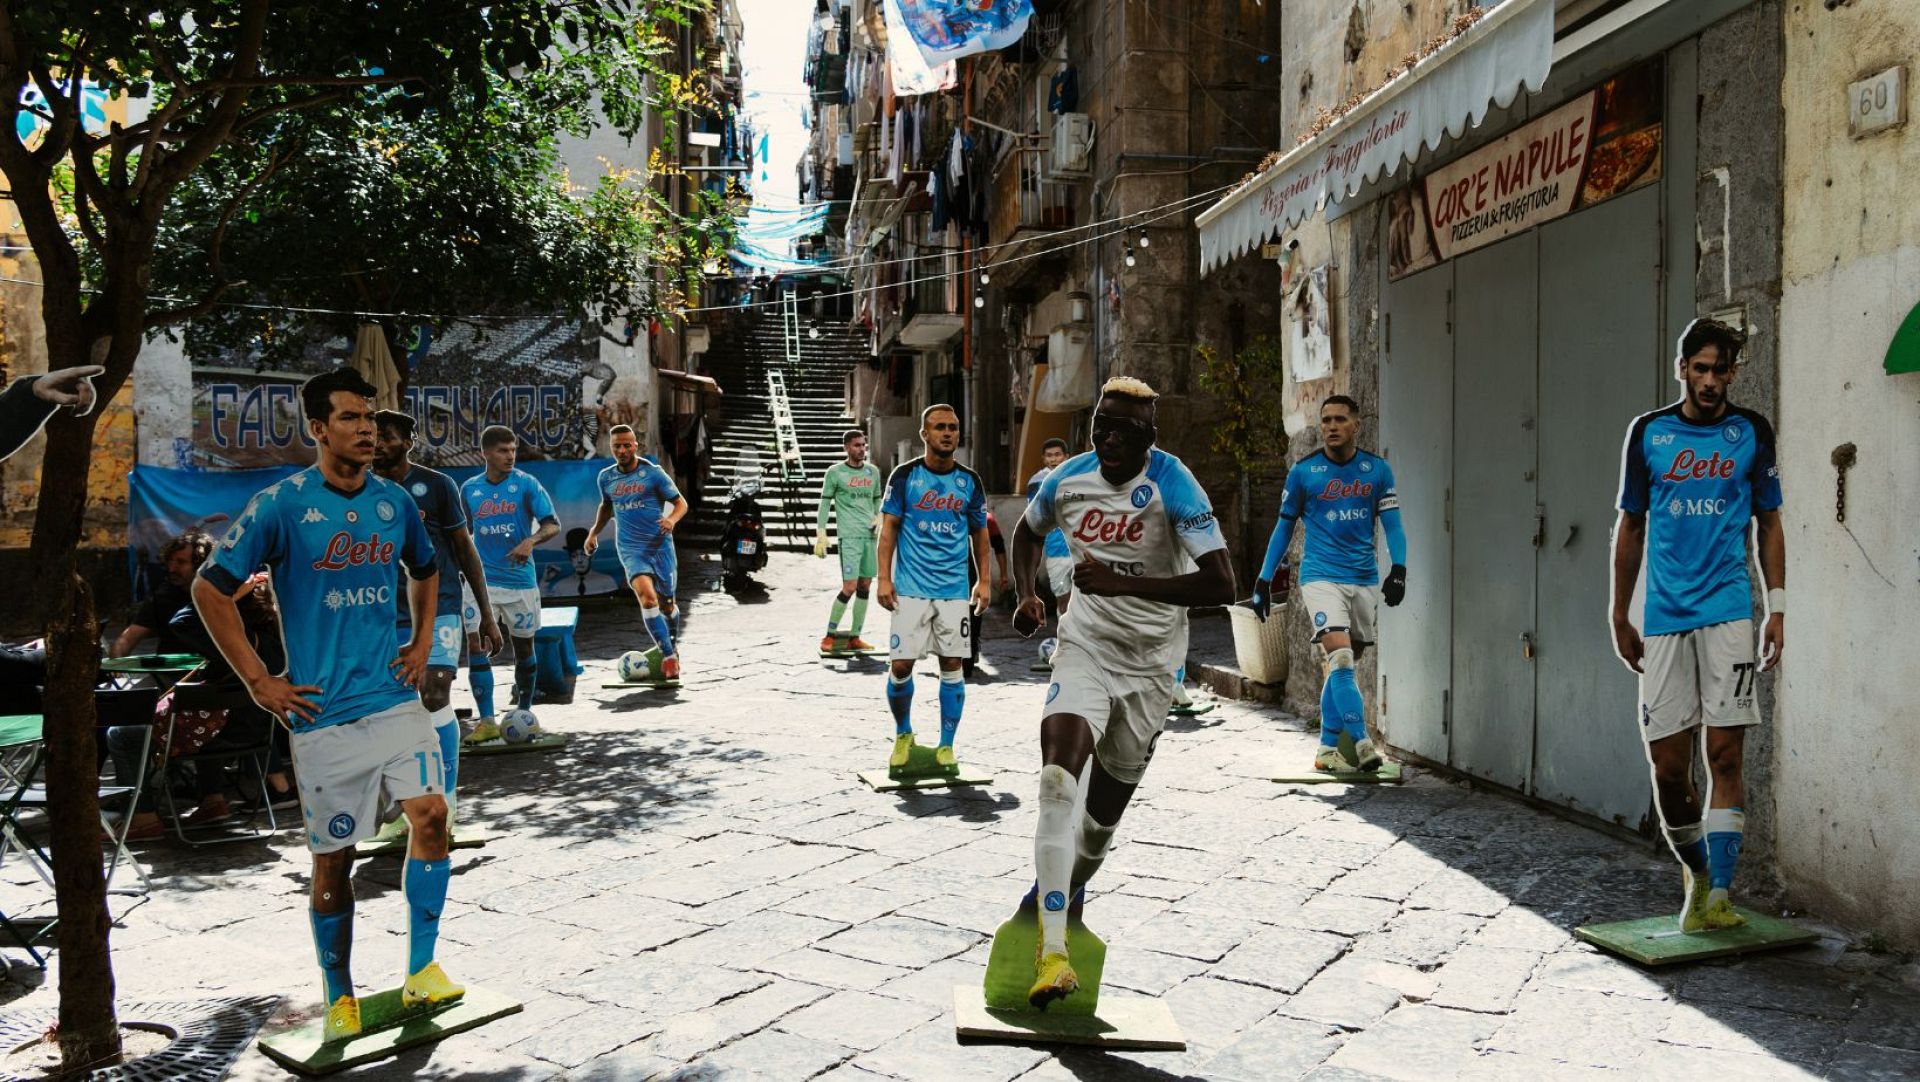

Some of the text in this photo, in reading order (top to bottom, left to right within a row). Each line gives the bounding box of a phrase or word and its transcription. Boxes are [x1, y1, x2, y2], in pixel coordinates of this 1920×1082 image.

[1859, 81, 1888, 116] 60
[1434, 115, 1585, 229] COR'E NAPULE
[1450, 213, 1490, 243] PIZZERIA
[1499, 181, 1560, 223] FRIGGITORIA
[1652, 434, 1676, 446] EA7
[1310, 465, 1328, 473] EA7
[1662, 447, 1736, 482] Lete
[912, 489, 964, 511] Lete
[1317, 478, 1373, 501] Lete
[475, 498, 517, 518] Lete
[1339, 508, 1369, 521] MSC
[1686, 499, 1726, 515] MSC
[489, 522, 516, 535] MSC
[930, 521, 957, 533] MSC
[1072, 508, 1145, 543] Lete
[312, 530, 394, 571] Lete
[345, 585, 391, 608] MSC
[513, 612, 535, 630] 22
[960, 616, 970, 638] 6
[1732, 662, 1756, 698] 77
[414, 751, 444, 787] 11
